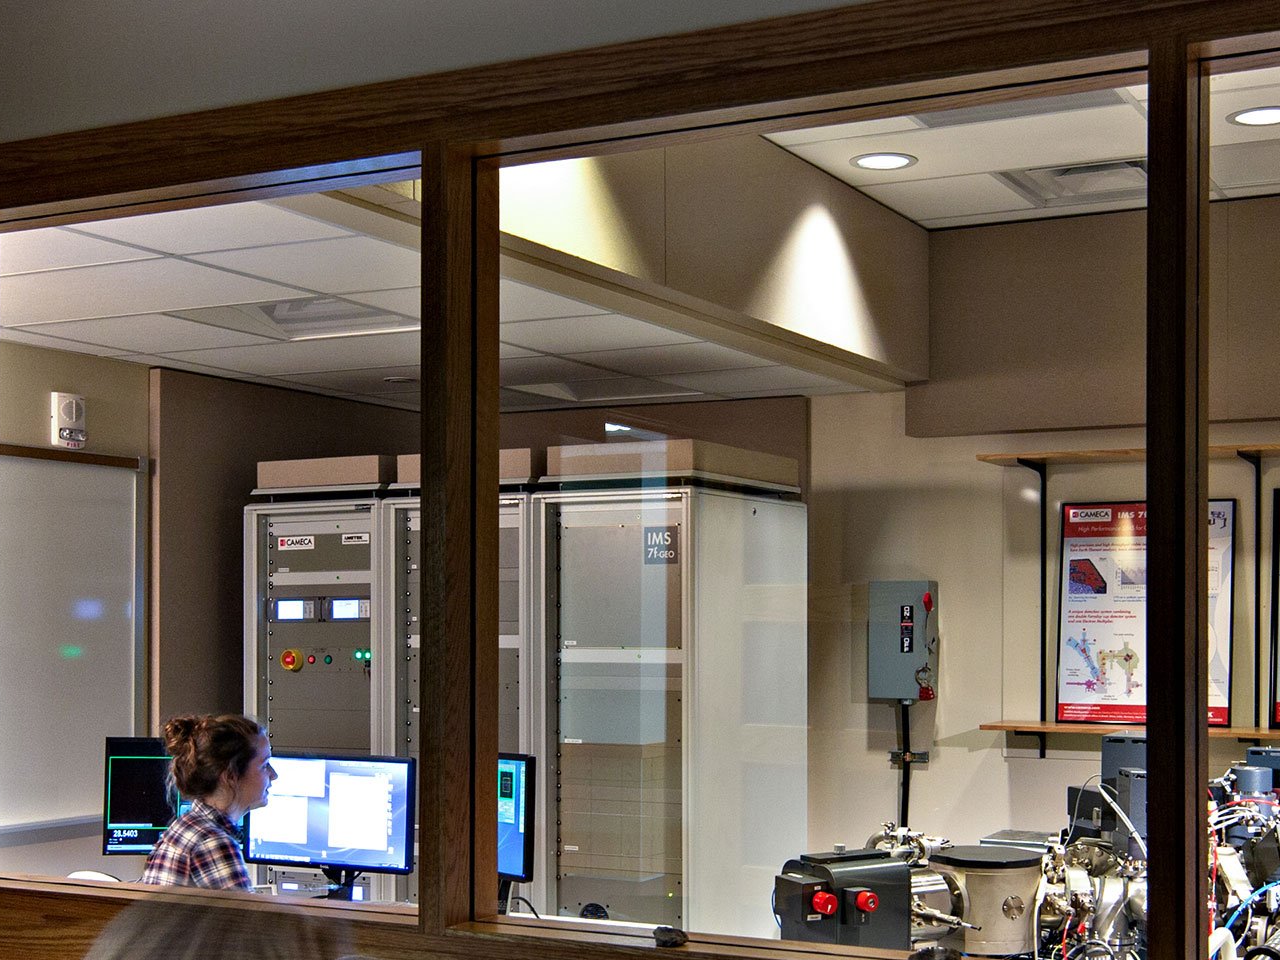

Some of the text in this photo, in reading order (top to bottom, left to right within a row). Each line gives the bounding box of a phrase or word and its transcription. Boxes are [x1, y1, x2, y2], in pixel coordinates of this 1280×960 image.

[1117, 511, 1135, 519] IMS
[286, 538, 313, 546] CAMECA
[647, 531, 672, 545] IMS
